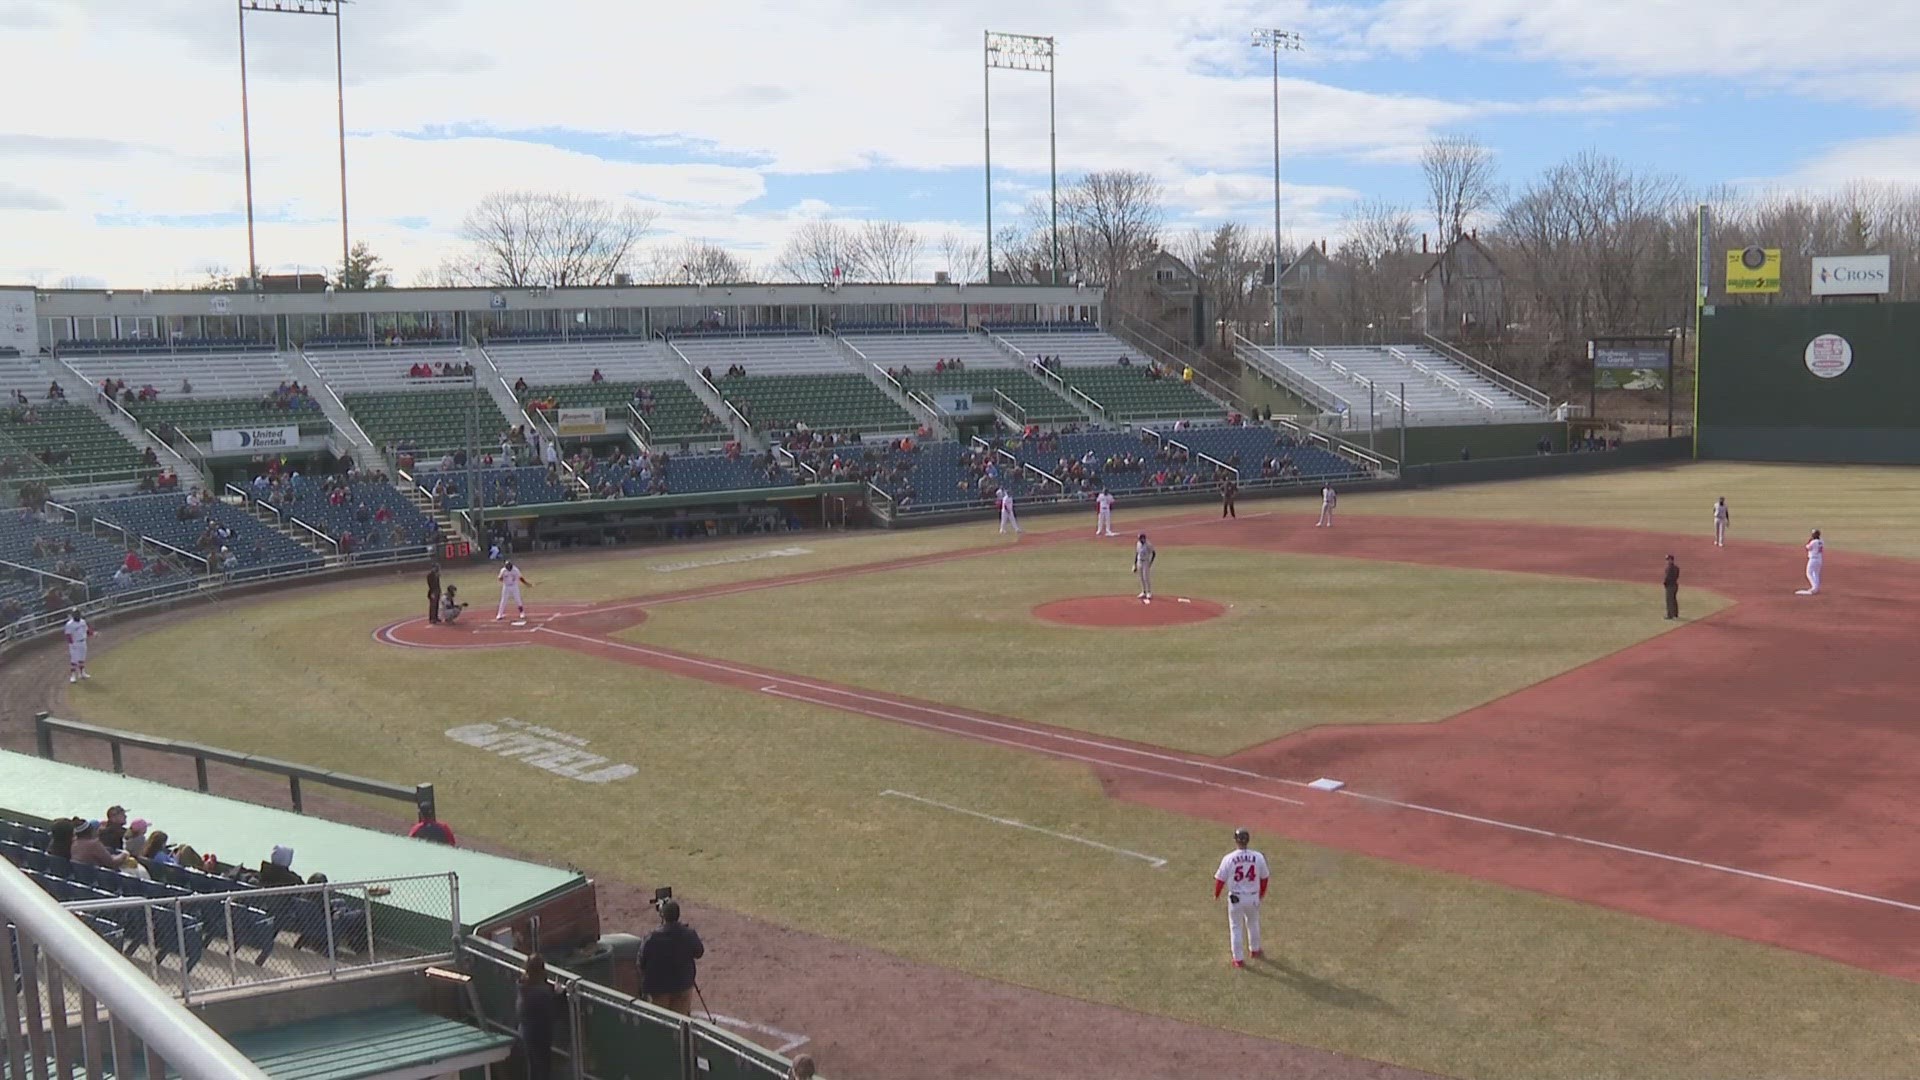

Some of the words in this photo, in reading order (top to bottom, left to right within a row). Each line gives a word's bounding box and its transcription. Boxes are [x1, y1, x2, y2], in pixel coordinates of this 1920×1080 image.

[252, 429, 284, 438] United
[252, 438, 287, 447] Rentals
[1233, 864, 1256, 882] 54
